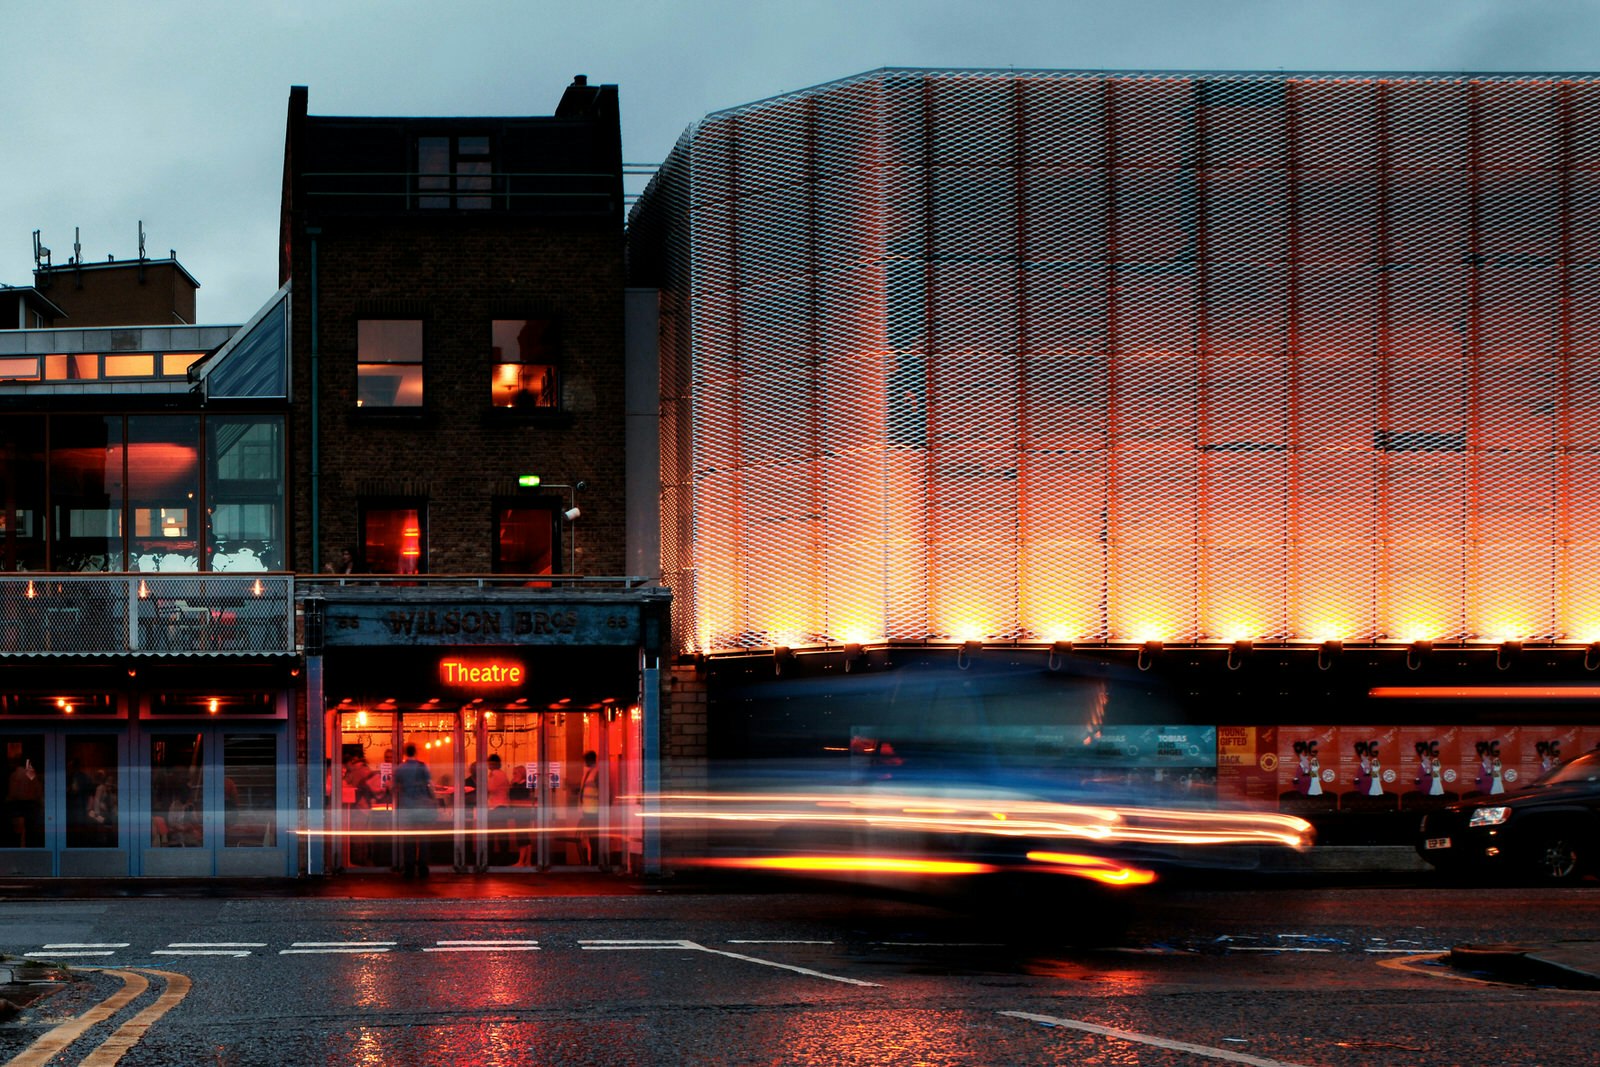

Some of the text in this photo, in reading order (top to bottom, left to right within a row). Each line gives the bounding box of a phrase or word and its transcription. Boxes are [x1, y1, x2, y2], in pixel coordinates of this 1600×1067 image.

[389, 611, 500, 635] WILSON
[443, 661, 520, 682] Theatre
[1158, 735, 1187, 743] TOBIAS
[1220, 738, 1247, 746] GIFTED
